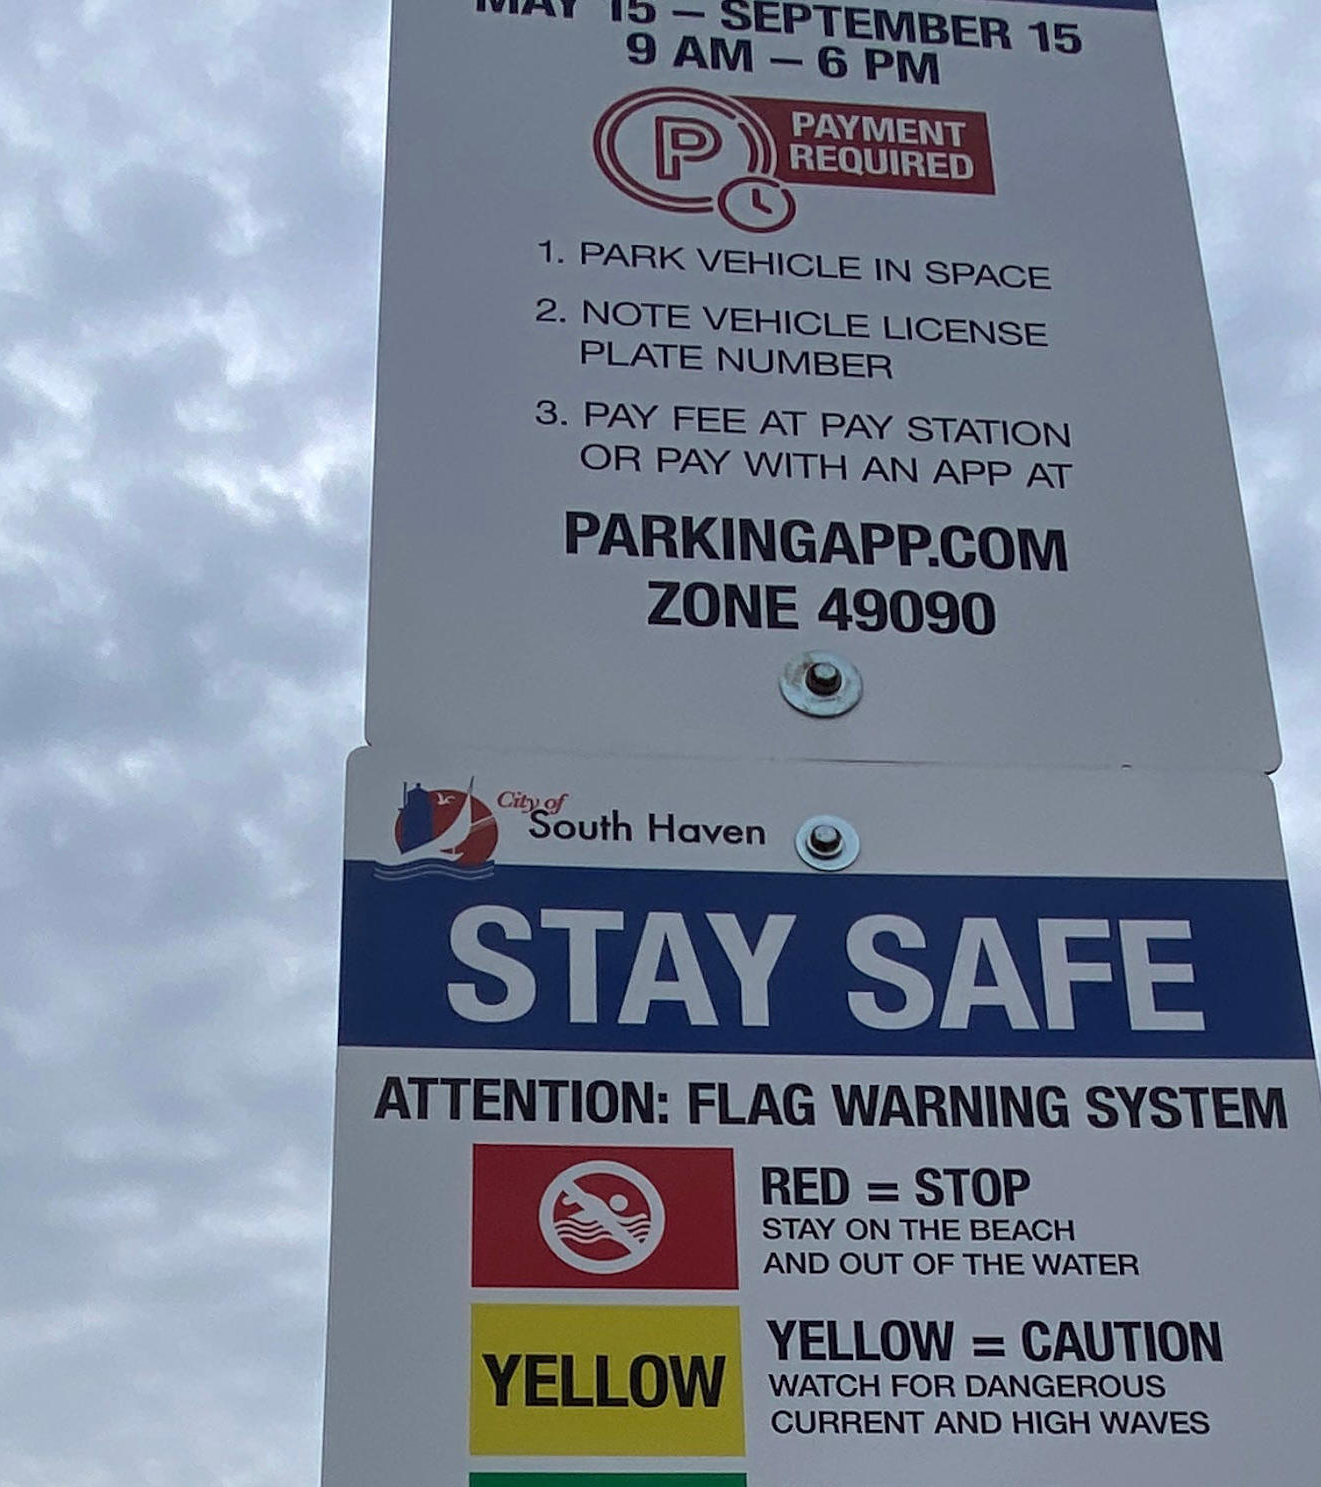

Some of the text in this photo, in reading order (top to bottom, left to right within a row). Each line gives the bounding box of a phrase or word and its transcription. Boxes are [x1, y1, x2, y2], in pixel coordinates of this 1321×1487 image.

[612, 0, 656, 23] 15
[720, 0, 1012, 50] SEPTEMBER
[1029, 21, 1081, 54] 15
[627, 32, 656, 64] 9
[673, 36, 752, 72] AM
[818, 46, 847, 78] 6
[865, 48, 939, 85] PM
[655, 115, 722, 181] P
[790, 111, 966, 147] PAYMENT
[790, 144, 973, 179] REQUIRED
[539, 240, 1051, 289] 1. PARK VEHICLE IN SPACE
[536, 298, 1048, 346] 2. NOTE VEHICLE LICENSE
[582, 340, 892, 379] PLATE NUMBER
[536, 400, 1070, 447] 3. PAY FEE AT PAY STATION
[581, 444, 1072, 489] OR PAY WITH AN APP AT
[566, 511, 1068, 571] PARKINGAPP.COM
[648, 581, 995, 635] ZONE 49090
[497, 790, 568, 815] City of
[529, 809, 765, 844] South Haven
[448, 905, 1205, 1030] STAY SAFE
[374, 1077, 1288, 1128] ATTENTION: FLAG WARNING SYSTEM
[762, 1167, 1030, 1206] RED = STOP
[763, 1218, 1074, 1241] STAY ON THE BEACH
[763, 1252, 1139, 1275] AND OUT OF THE WATER
[766, 1320, 1223, 1361] YELLOW = CAUTION
[482, 1354, 725, 1407] YELLOW
[768, 1374, 1165, 1397] WATCH FOR DANGEROUS
[772, 1410, 1210, 1434] CURRENT AND HIGH WAVES
